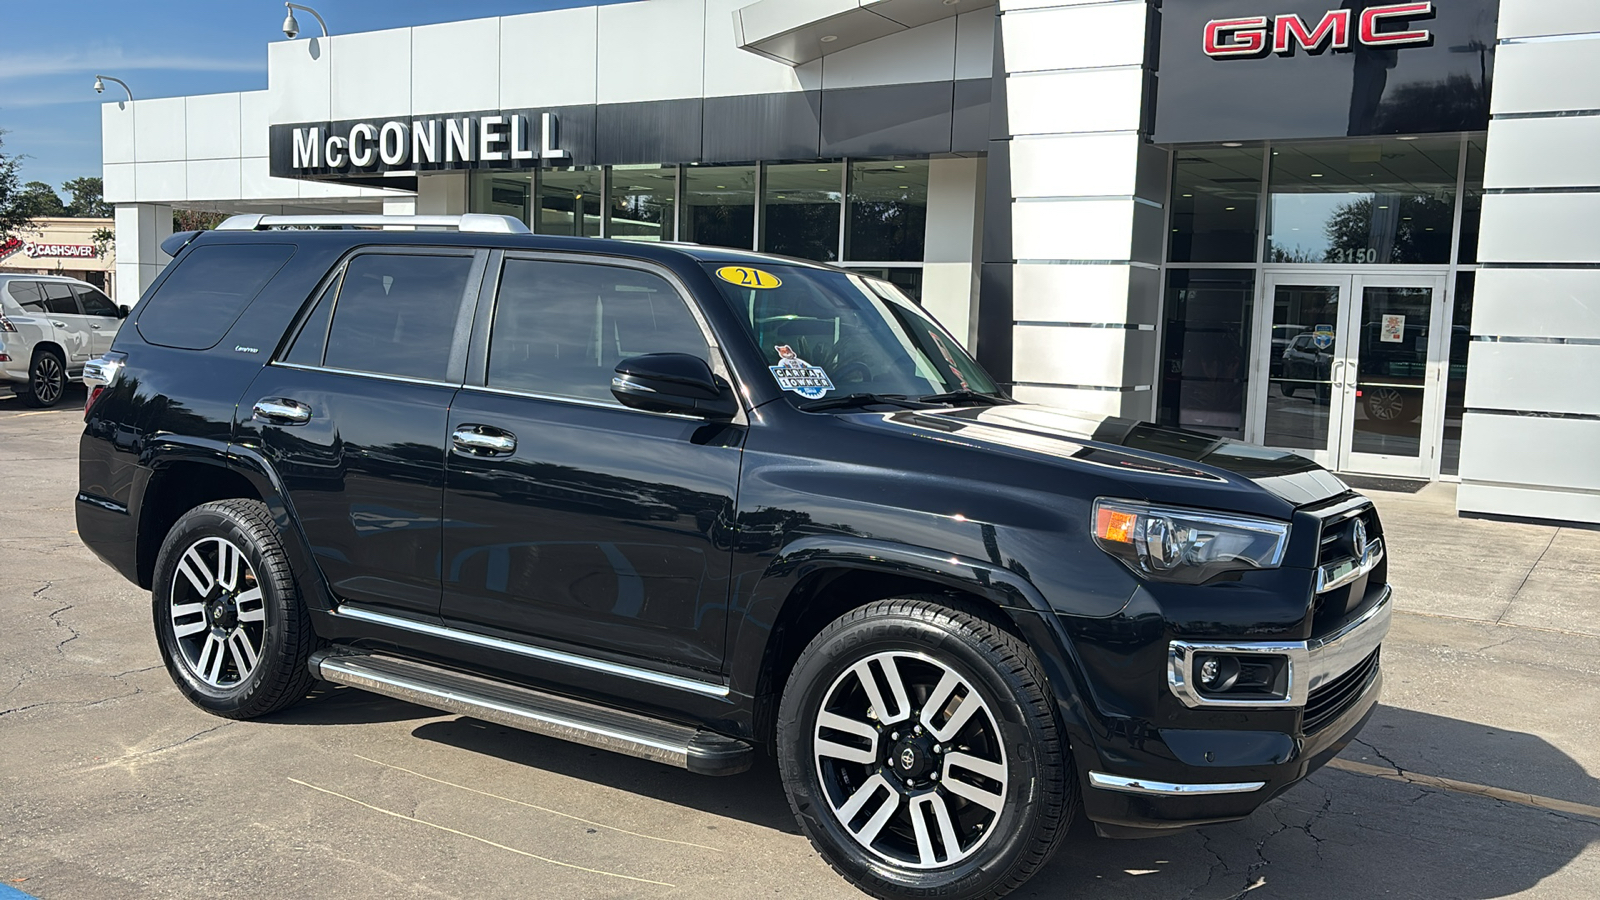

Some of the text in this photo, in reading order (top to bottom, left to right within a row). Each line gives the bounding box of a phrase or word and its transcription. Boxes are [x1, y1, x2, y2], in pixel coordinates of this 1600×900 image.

[1203, 1, 1432, 56] GMC
[292, 113, 565, 169] McCONNELL
[37, 245, 92, 256] CASHSAVER
[1333, 248, 1377, 263] 3150
[736, 268, 765, 286] 21
[776, 369, 825, 378] CARFAX
